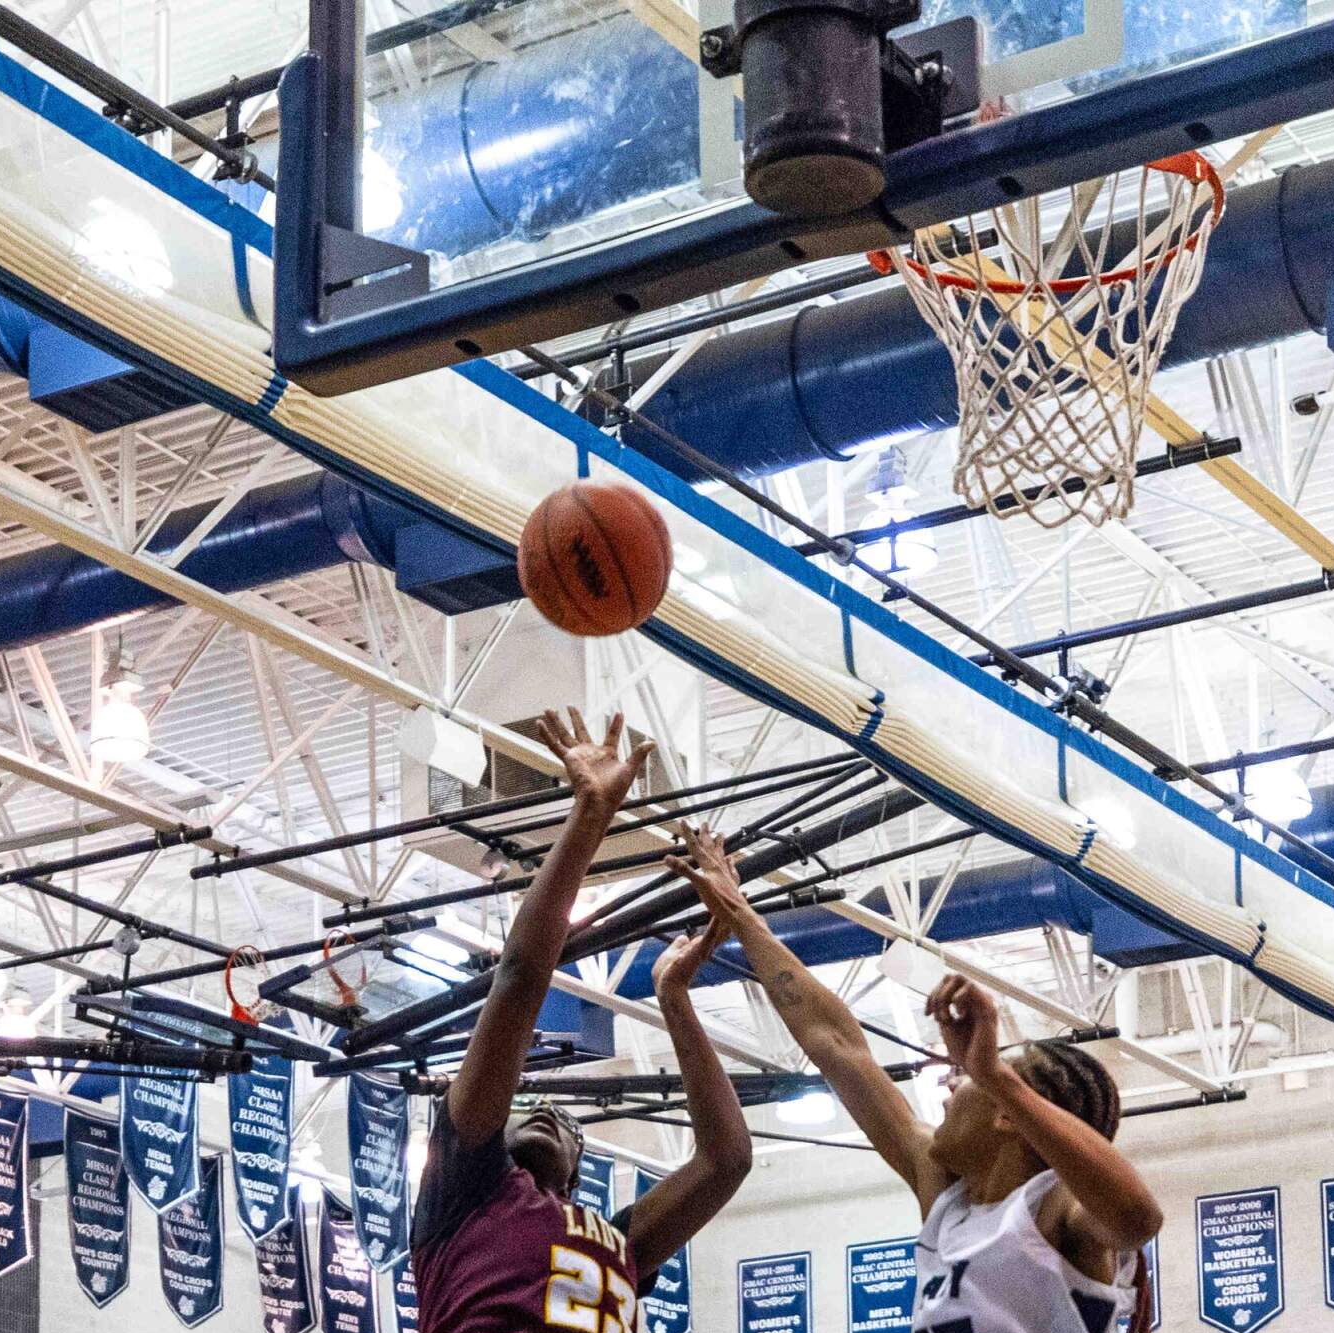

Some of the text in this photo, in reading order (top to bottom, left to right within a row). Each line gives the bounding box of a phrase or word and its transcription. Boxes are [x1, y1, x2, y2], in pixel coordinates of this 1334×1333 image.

[565, 1204, 628, 1266] LADY
[1203, 1220, 1275, 1237] CHAMPIONS
[1213, 1246, 1266, 1261] WOMEN'S
[1204, 1255, 1276, 1272] BASKETBALL
[1213, 1272, 1267, 1288] WOMEN'S
[743, 1281, 806, 1299] CHAMPIONS
[1221, 1283, 1260, 1296] CROSS
[1214, 1292, 1267, 1307] COUNTRY
[868, 1306, 902, 1319] MEN'S
[748, 1314, 801, 1330] WOMEN'S
